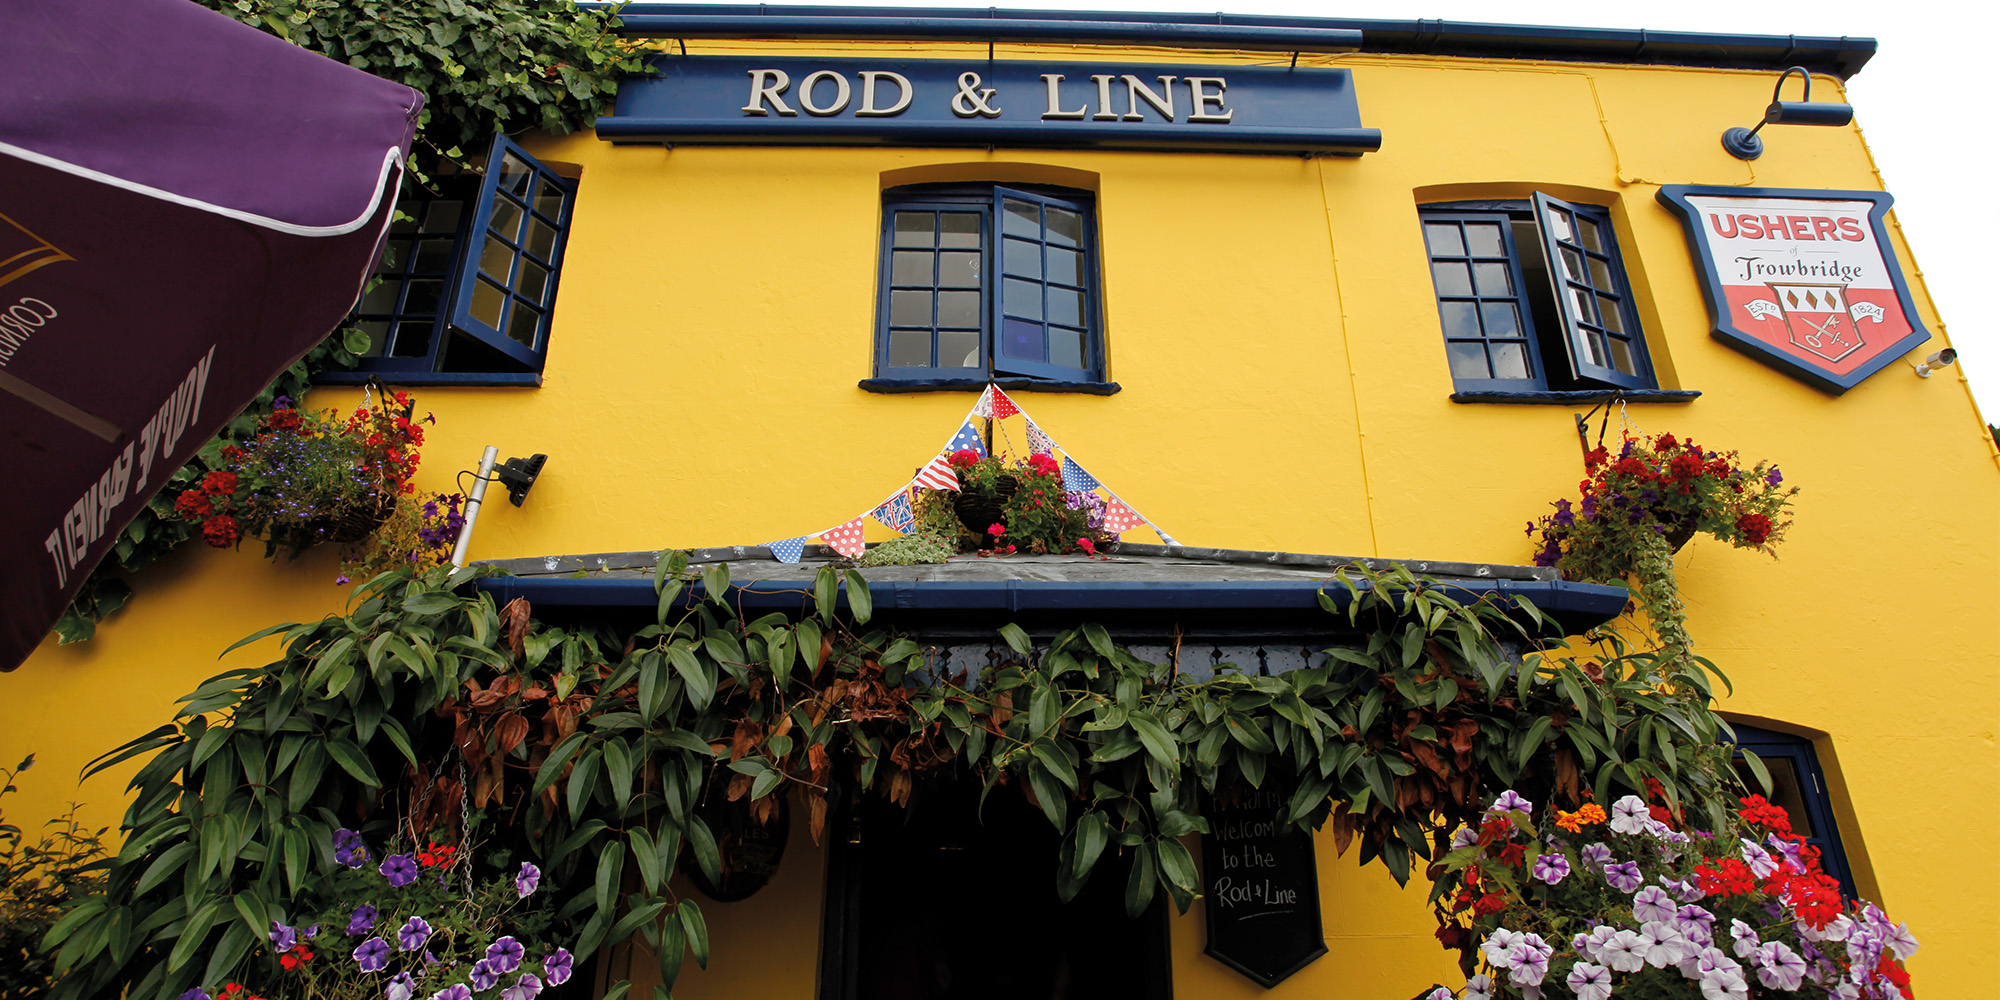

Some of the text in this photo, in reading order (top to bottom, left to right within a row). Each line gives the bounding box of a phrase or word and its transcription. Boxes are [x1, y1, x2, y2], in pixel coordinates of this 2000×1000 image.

[741, 68, 1235, 124] ROD & LINE
[1709, 213, 1865, 242] USHERS
[1789, 245, 1799, 257] of
[1735, 256, 1863, 282] Trowbridge
[1854, 304, 1883, 317] 1824
[1213, 818, 1276, 841] Welcom
[1222, 845, 1277, 869] to the
[1214, 876, 1253, 908] Rod
[1264, 879, 1297, 905] Line
